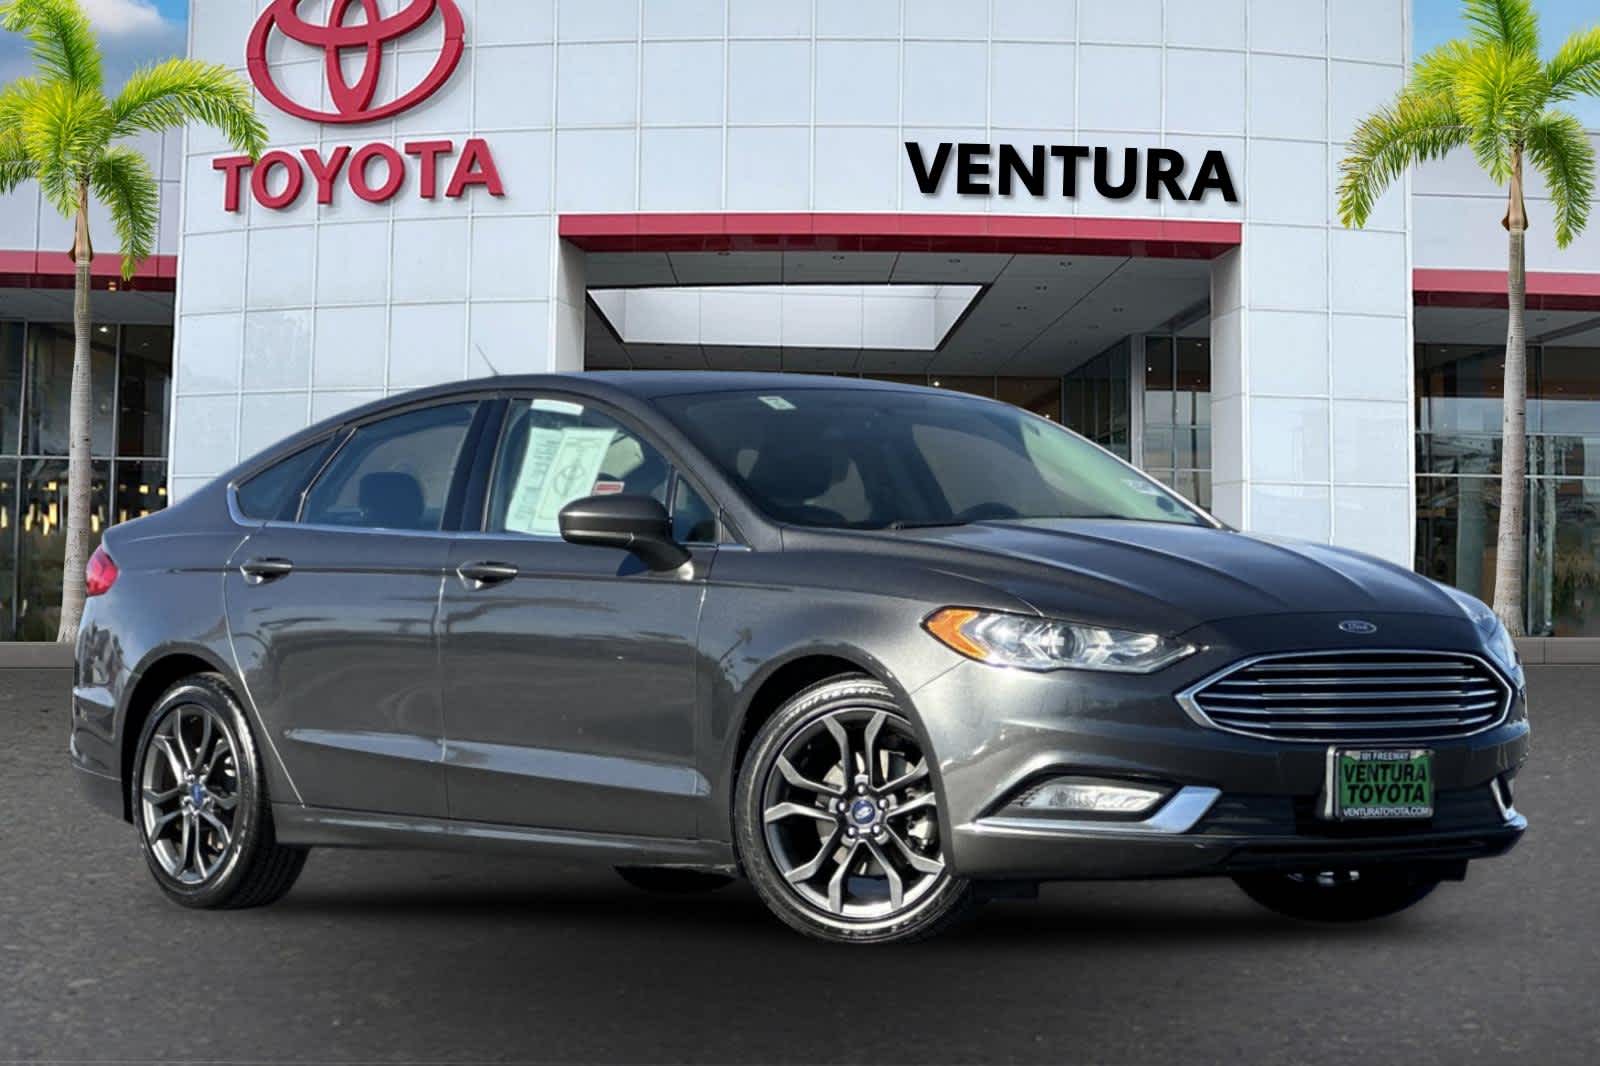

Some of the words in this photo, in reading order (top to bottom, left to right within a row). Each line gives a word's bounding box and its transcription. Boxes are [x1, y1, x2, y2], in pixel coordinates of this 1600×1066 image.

[213, 138, 505, 213] TOYOTA
[904, 141, 1238, 203] VENTURA
[1343, 763, 1427, 782] VENTURA
[1347, 783, 1426, 804] TOYOTA
